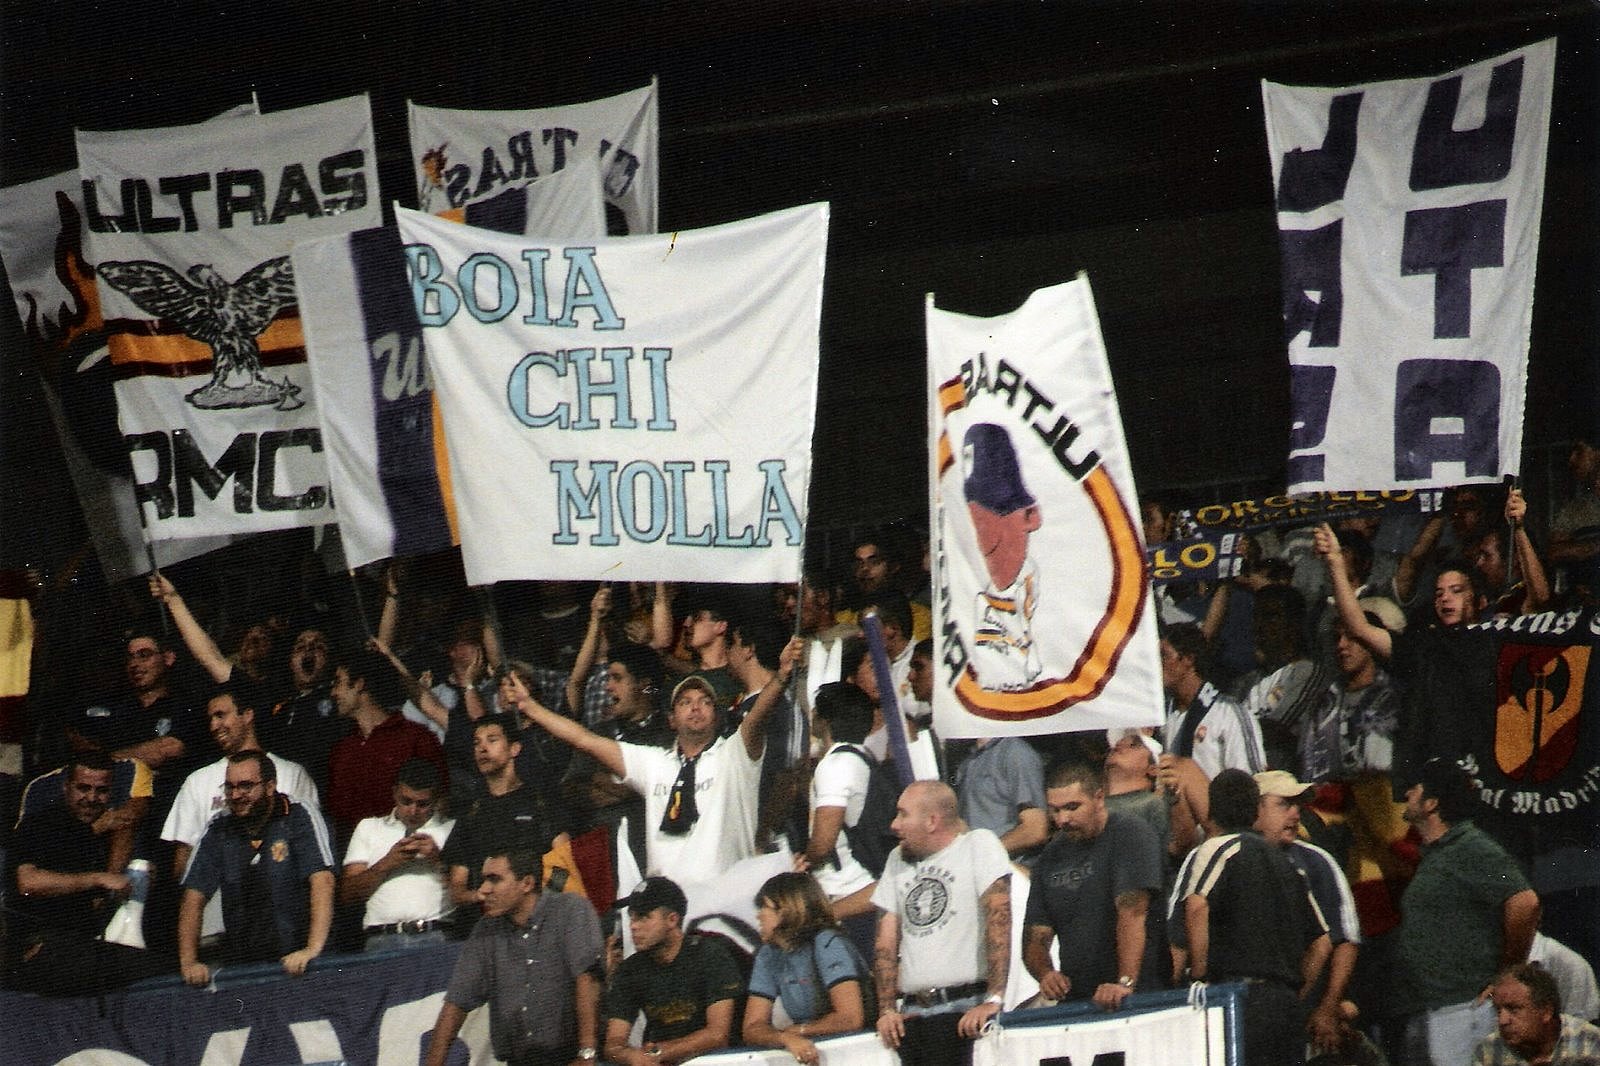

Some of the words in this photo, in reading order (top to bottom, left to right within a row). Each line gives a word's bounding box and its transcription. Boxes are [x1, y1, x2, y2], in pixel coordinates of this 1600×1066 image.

[82, 149, 368, 234] ULTRAS
[404, 244, 625, 330] BOIA
[507, 346, 674, 432] CHI
[550, 460, 803, 548] MOLLA
[1196, 489, 1416, 525] ORGLLO
